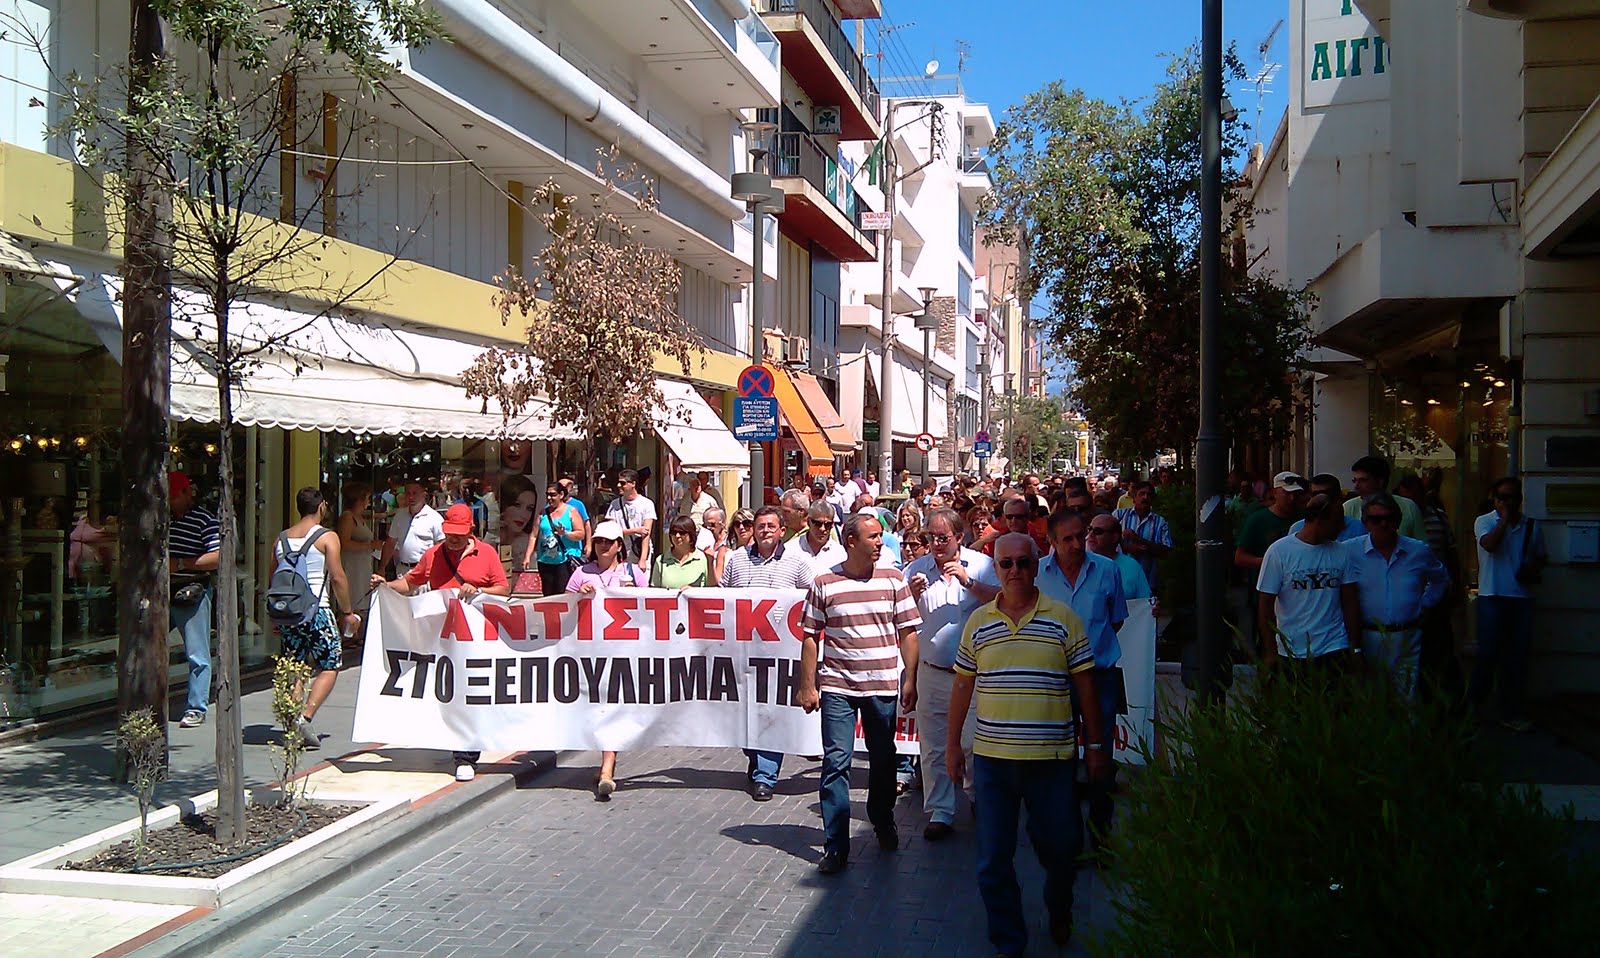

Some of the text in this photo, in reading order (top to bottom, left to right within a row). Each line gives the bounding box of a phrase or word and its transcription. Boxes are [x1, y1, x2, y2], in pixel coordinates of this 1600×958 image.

[1311, 36, 1391, 81] ΑΙΓΙ
[1291, 572, 1340, 590] NYC
[380, 649, 455, 704] ΣΤΟ
[465, 655, 740, 706] ΞΕΠΟΥΛΗΜΑ
